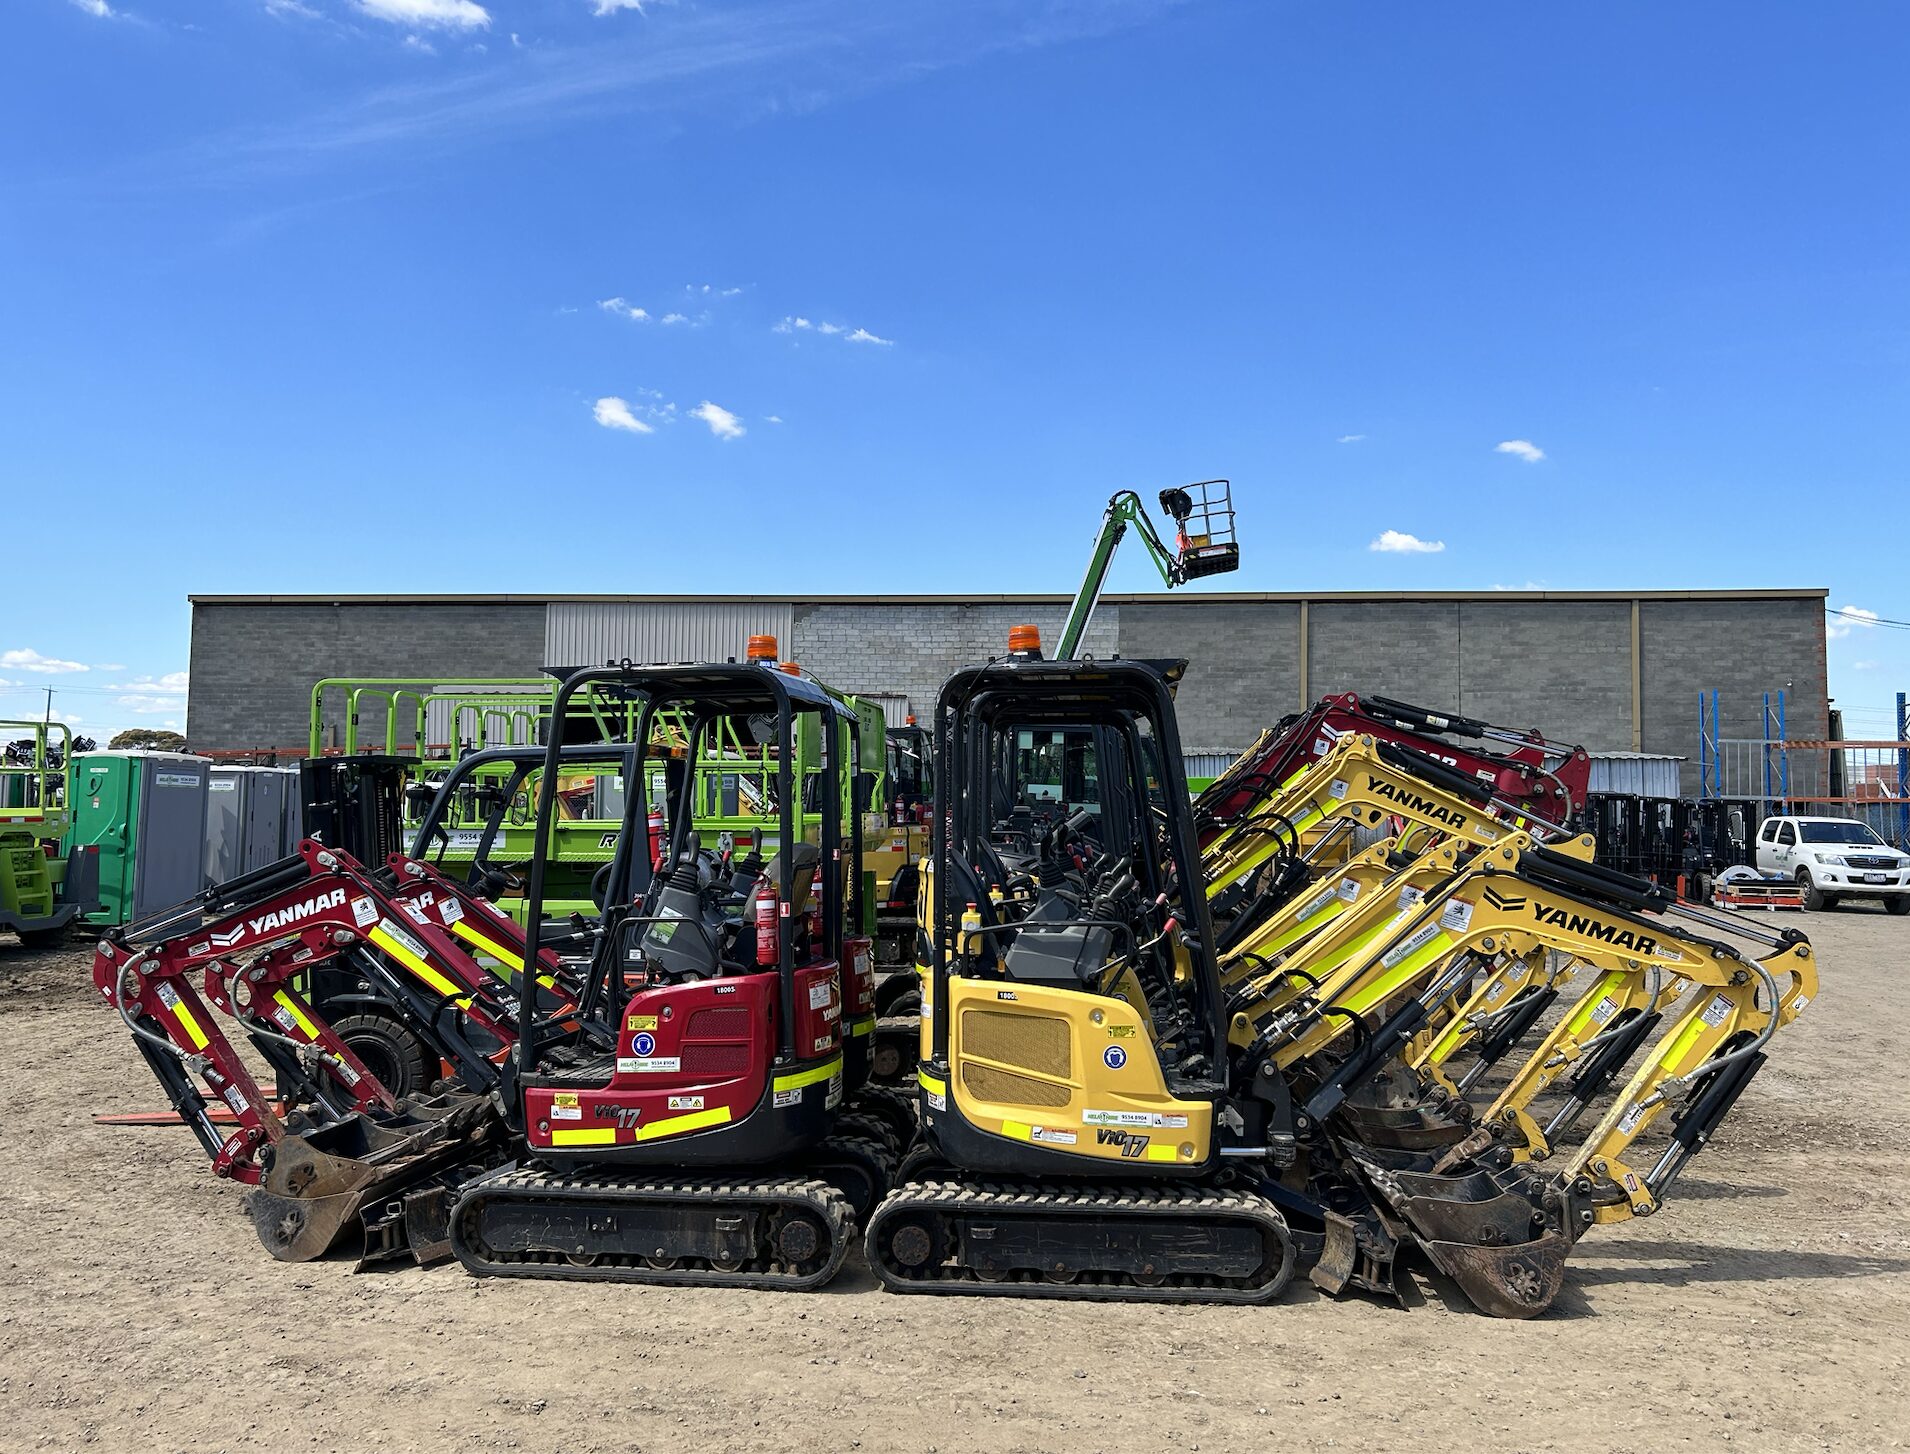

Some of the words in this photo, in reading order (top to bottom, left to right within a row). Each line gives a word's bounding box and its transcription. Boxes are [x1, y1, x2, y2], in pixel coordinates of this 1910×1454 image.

[1367, 776, 1467, 829] YANMAR
[459, 833, 477, 841] 9554
[248, 888, 346, 935] YANMAR
[1533, 902, 1657, 955] YANMAR
